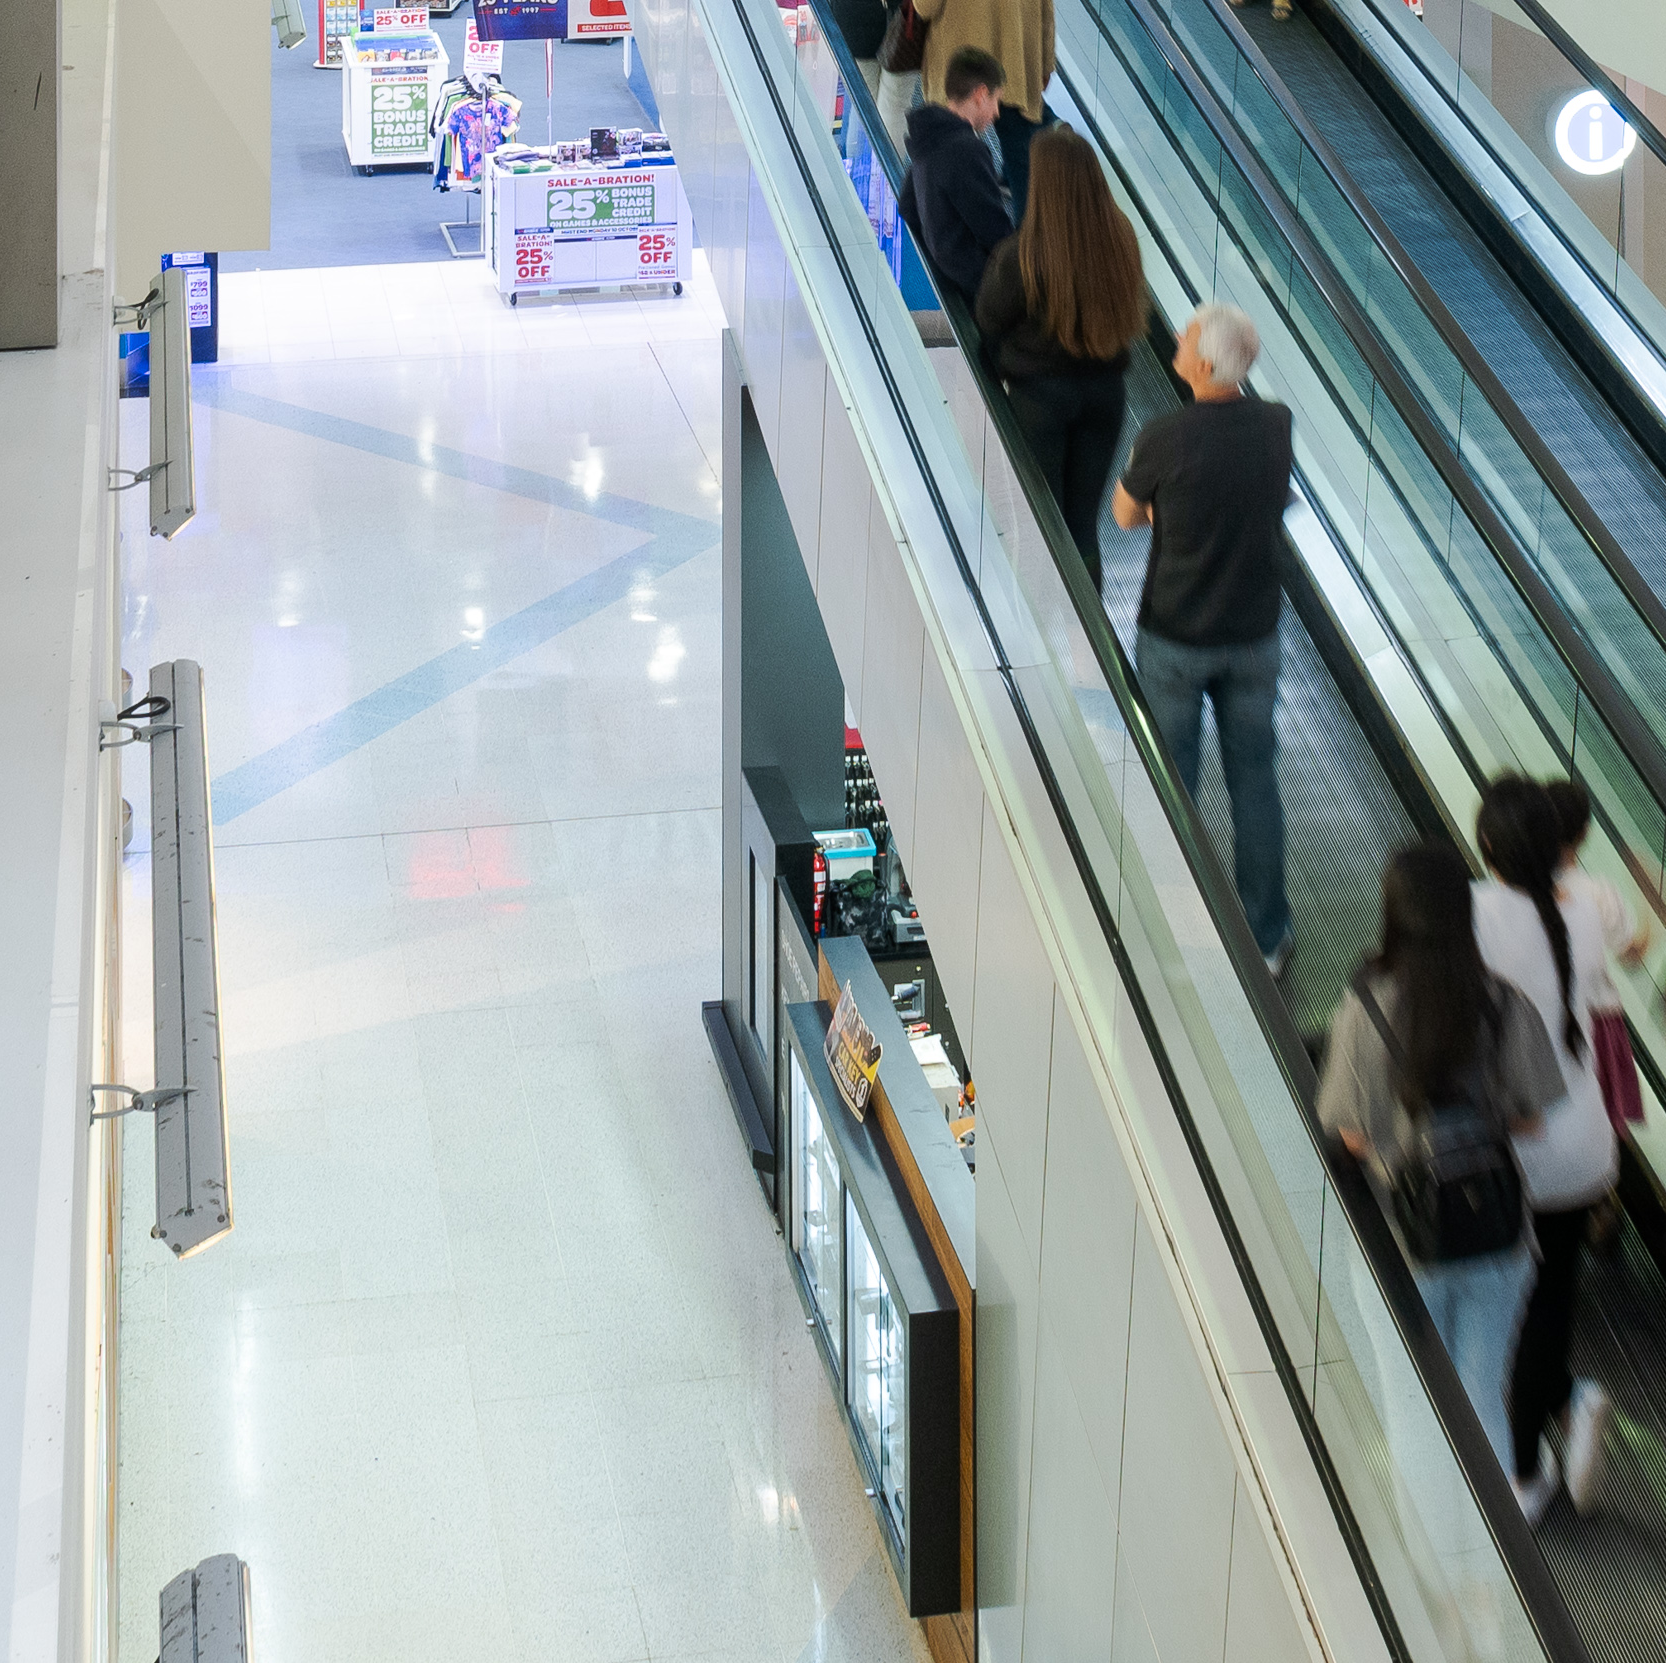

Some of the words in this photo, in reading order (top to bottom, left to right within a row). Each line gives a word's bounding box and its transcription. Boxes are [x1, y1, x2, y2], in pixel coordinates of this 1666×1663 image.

[400, 14, 427, 24] OFF
[469, 42, 499, 53] OFF
[374, 85, 426, 110] 25%
[374, 110, 426, 123] BONUS
[374, 122, 426, 135] TRADE
[374, 135, 426, 148] CREDIT
[547, 174, 655, 188] SALE-A-BRATION!
[612, 186, 652, 198] BONUS
[549, 189, 609, 220] 25%
[612, 197, 652, 208] TRADE
[612, 207, 652, 217] CREDIT
[598, 216, 652, 226] ACCESSORIES
[638, 234, 675, 251] 25%
[516, 248, 553, 265] 25%
[640, 251, 672, 264] OFF
[518, 265, 550, 278] OFF
